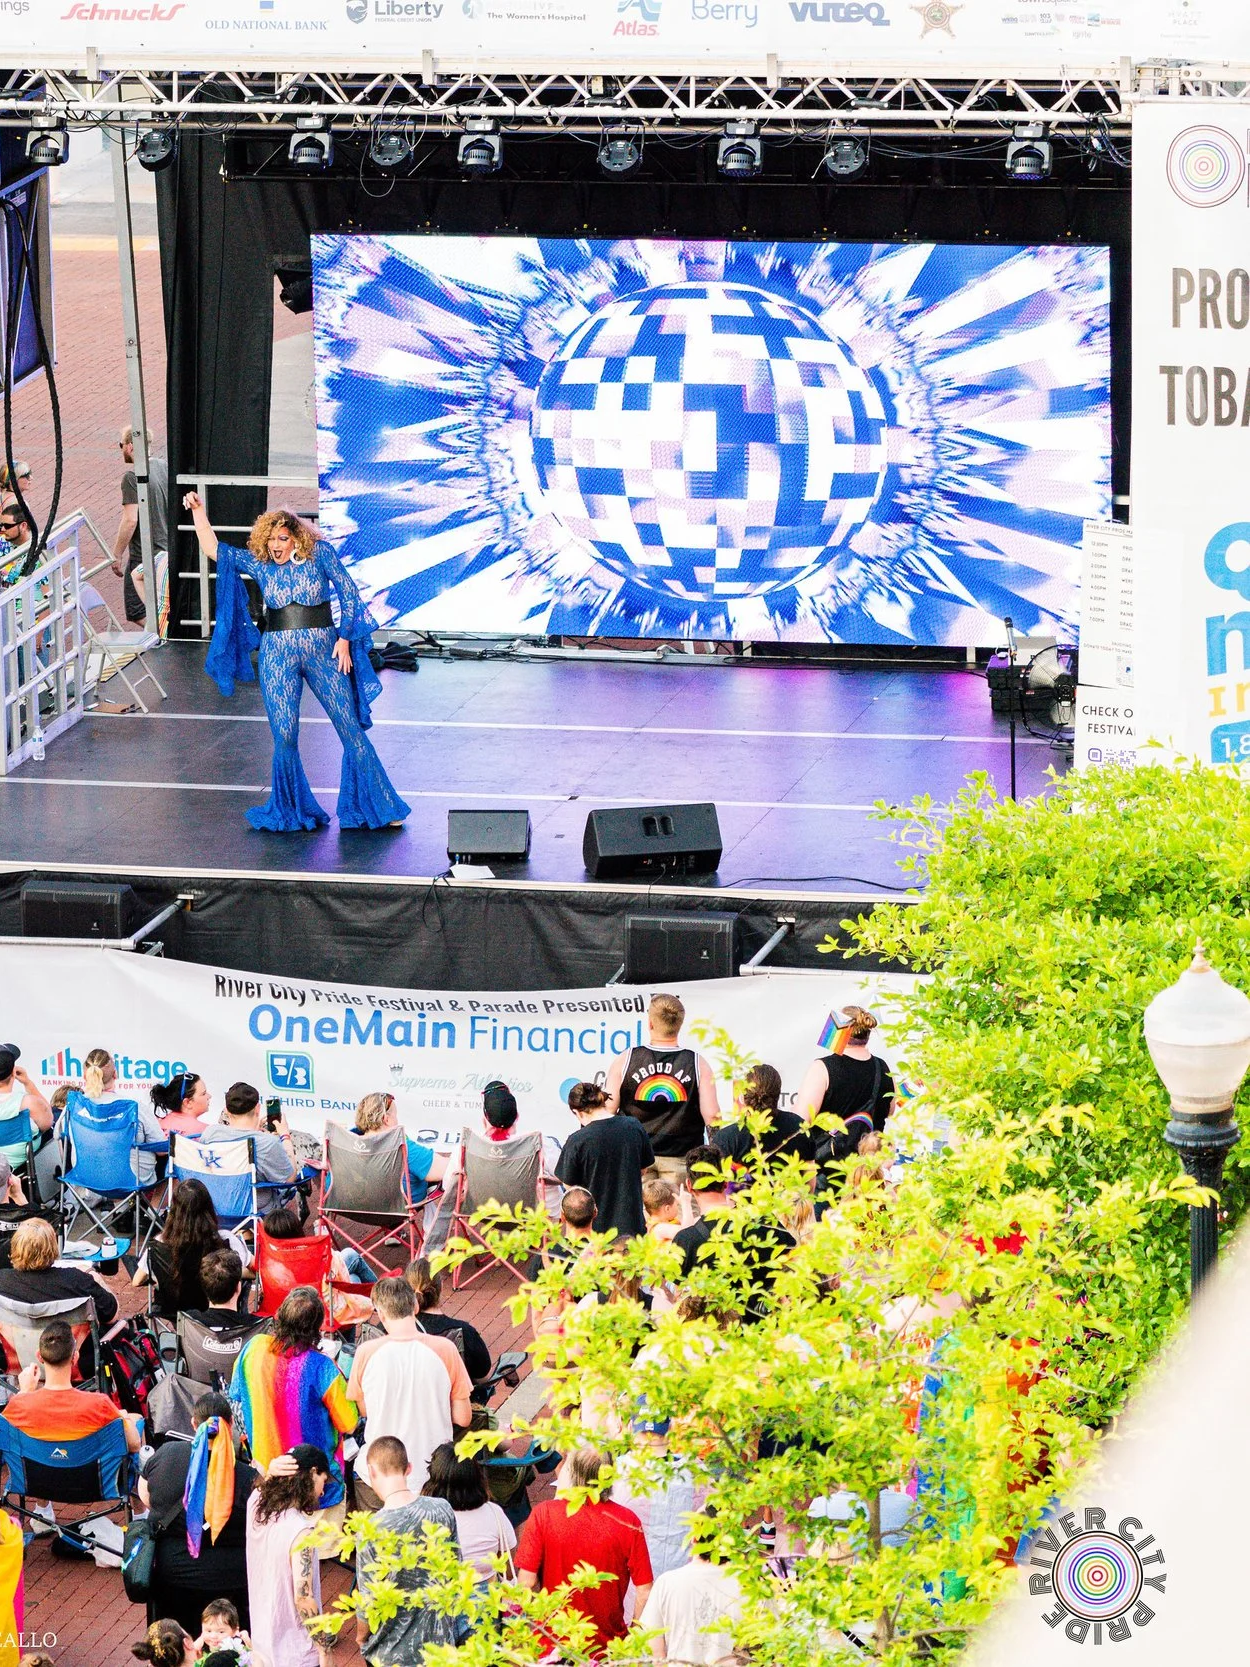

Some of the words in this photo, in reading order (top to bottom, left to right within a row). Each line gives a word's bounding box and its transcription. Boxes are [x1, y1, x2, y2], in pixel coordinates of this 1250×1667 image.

[60, 3, 186, 21] Schnucks
[374, 0, 443, 17] Liberty
[506, 12, 546, 20] Women's
[547, 13, 586, 22] Hospital
[691, 0, 758, 28] Berry
[205, 20, 229, 30] OLD
[232, 20, 292, 30] NATIONAL
[295, 20, 328, 30] BANK
[1082, 705, 1119, 717] CHECK
[1087, 722, 1136, 737] FESTIVA
[214, 973, 263, 999] River
[268, 983, 306, 1008] City
[310, 988, 363, 1008] Pride
[366, 995, 444, 1013] Festival
[450, 1000, 465, 1012] &
[469, 1000, 539, 1014] Parade
[544, 993, 645, 1015] Presented
[249, 1003, 456, 1049] OneMain
[469, 1015, 644, 1055] Financial
[65, 1047, 188, 1087] hitage
[631, 1062, 673, 1084] PROUD
[674, 1069, 692, 1085] AF
[388, 1071, 457, 1093] Supreme
[461, 1073, 534, 1093] Athltics
[422, 1100, 451, 1108] CHEER
